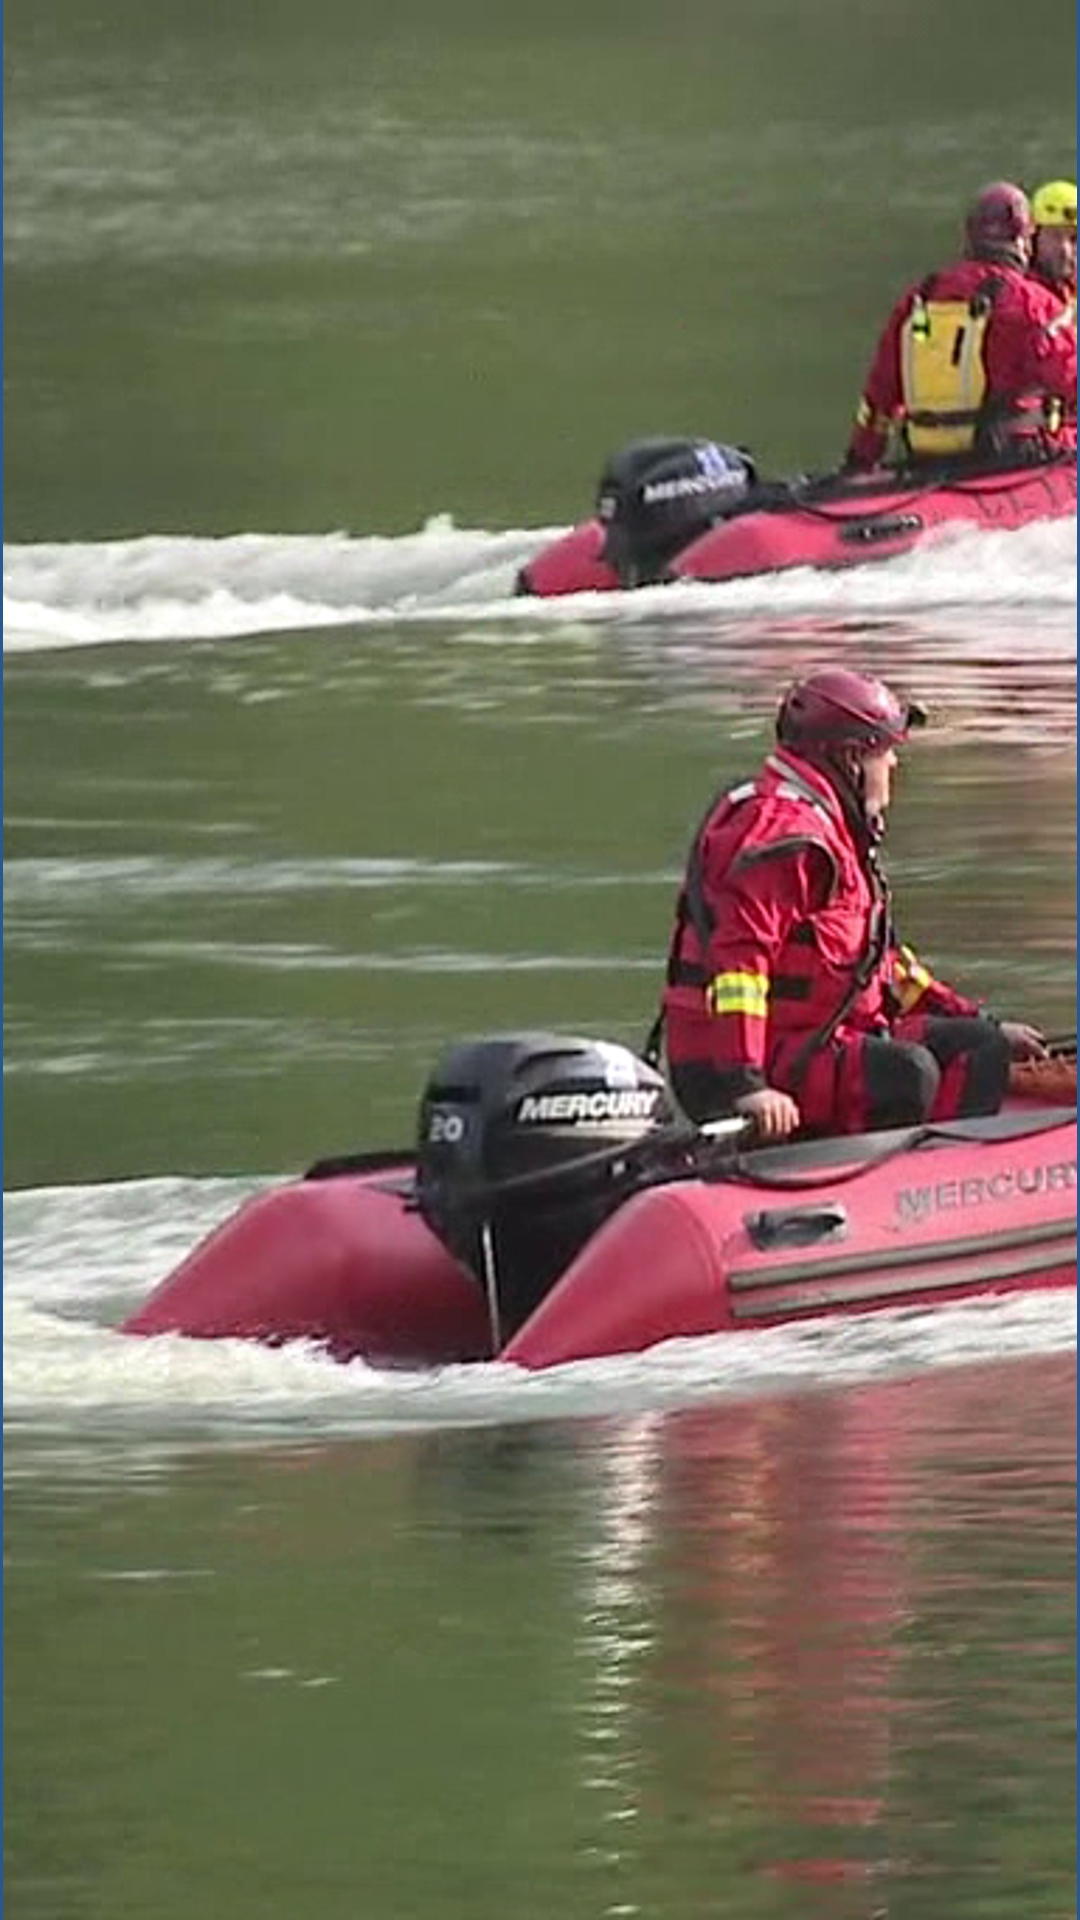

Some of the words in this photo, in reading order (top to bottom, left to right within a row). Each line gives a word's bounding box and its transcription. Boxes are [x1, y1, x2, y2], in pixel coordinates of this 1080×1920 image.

[518, 1091, 659, 1121] MERCURY
[430, 1114, 464, 1143] 20
[894, 1161, 1077, 1219] MERCUR
